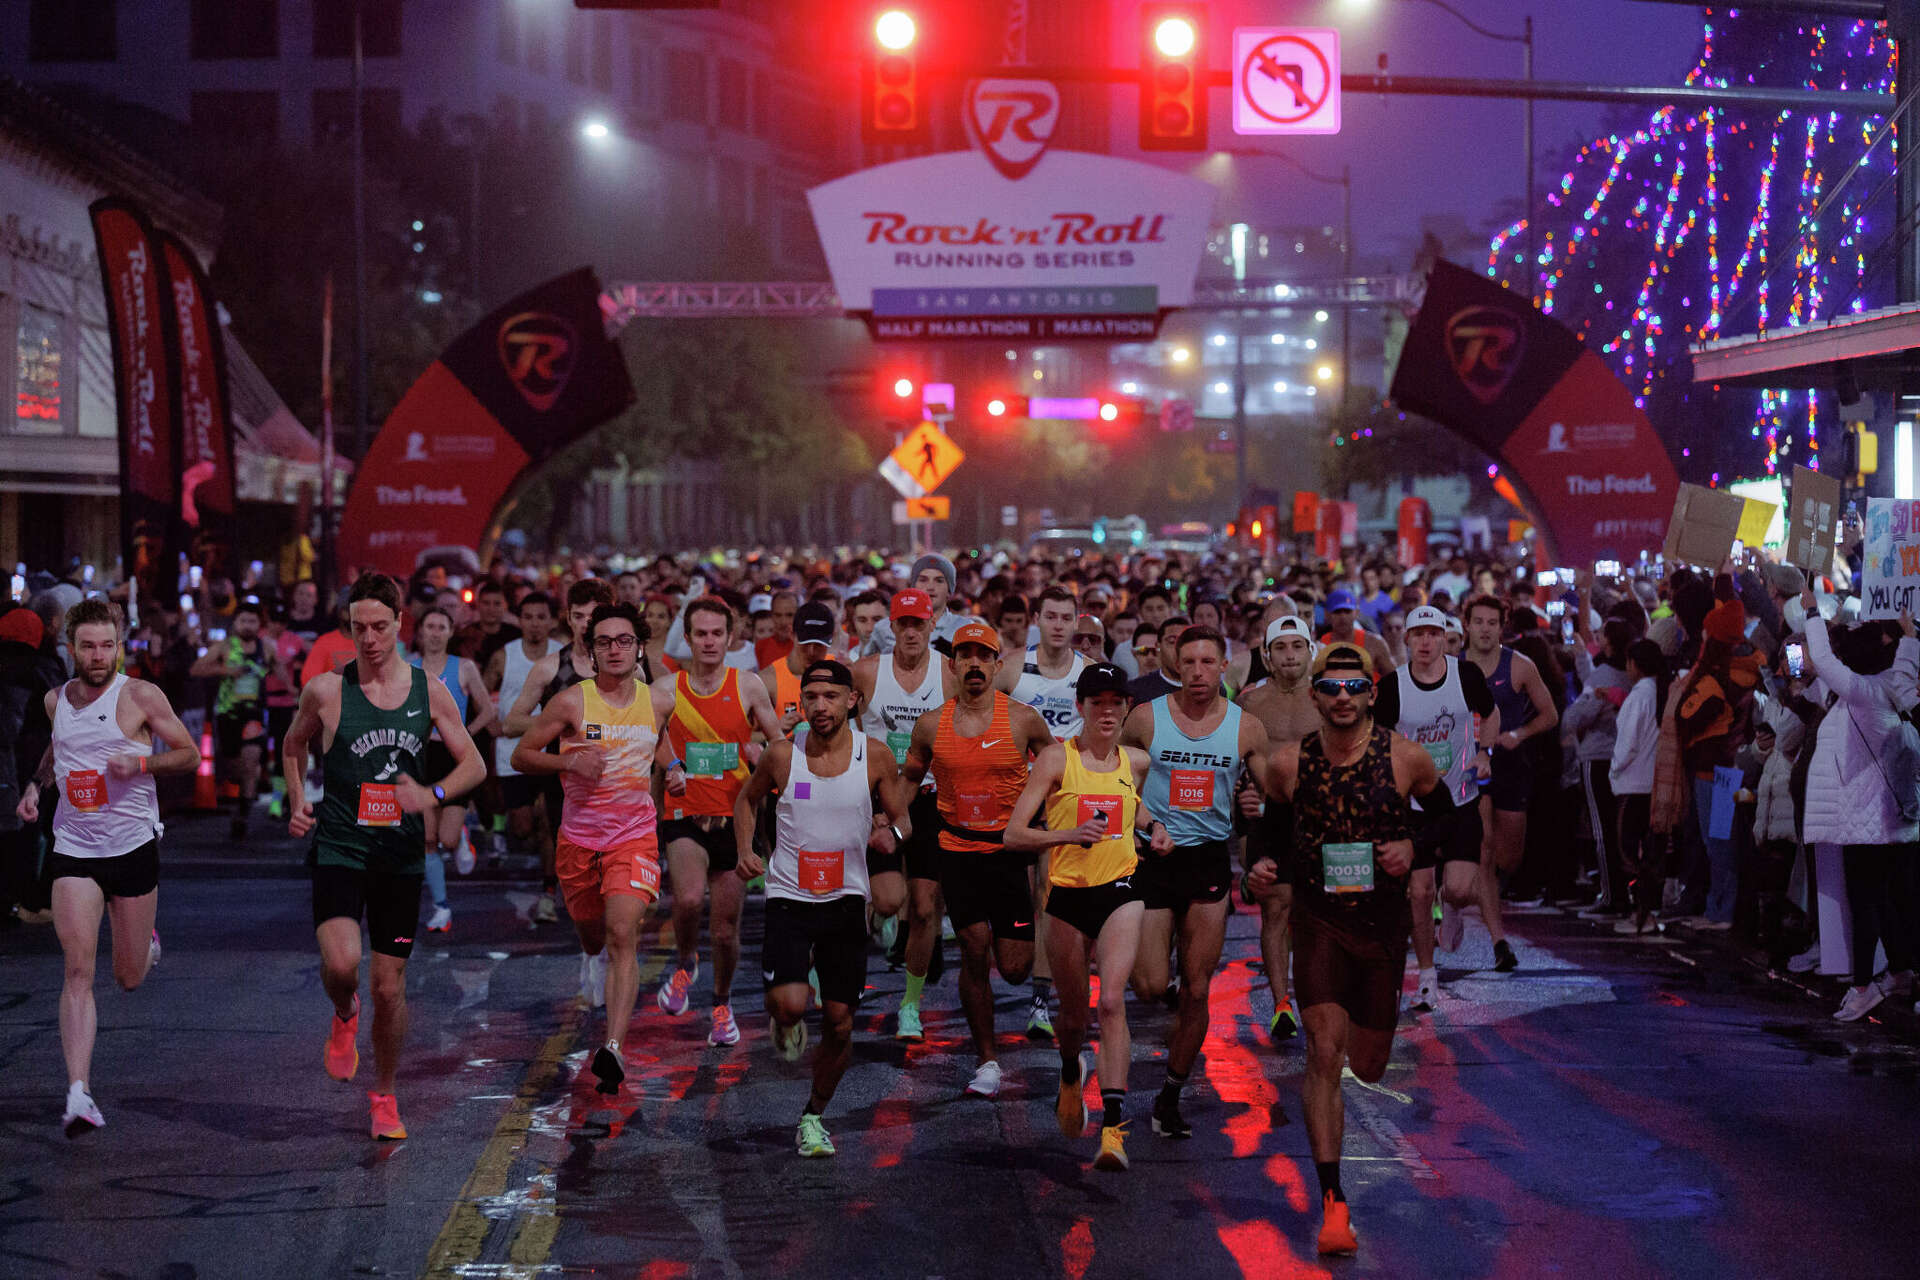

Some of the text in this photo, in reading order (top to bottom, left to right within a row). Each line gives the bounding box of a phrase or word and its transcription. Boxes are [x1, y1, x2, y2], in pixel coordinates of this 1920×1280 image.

[862, 212, 1004, 245] Rock
[1052, 213, 1167, 244] Roll
[895, 251, 1134, 269] RUNNING SERIES
[917, 291, 1117, 309] SAN ANTONIO
[877, 319, 1155, 336] HALF MARATHON MARATHON
[128, 241, 148, 337] Rock
[138, 367, 155, 454] Roll
[1566, 474, 1602, 496] The
[376, 484, 413, 506] The
[1868, 584, 1916, 616] YOU GOT
[350, 728, 397, 758] SECOND
[1416, 729, 1450, 745] RUN
[1160, 750, 1232, 767] SEATTLE
[1179, 788, 1205, 798] 1016
[367, 802, 395, 813] 1020
[817, 871, 825, 881] 3
[1326, 863, 1371, 877] 20030
